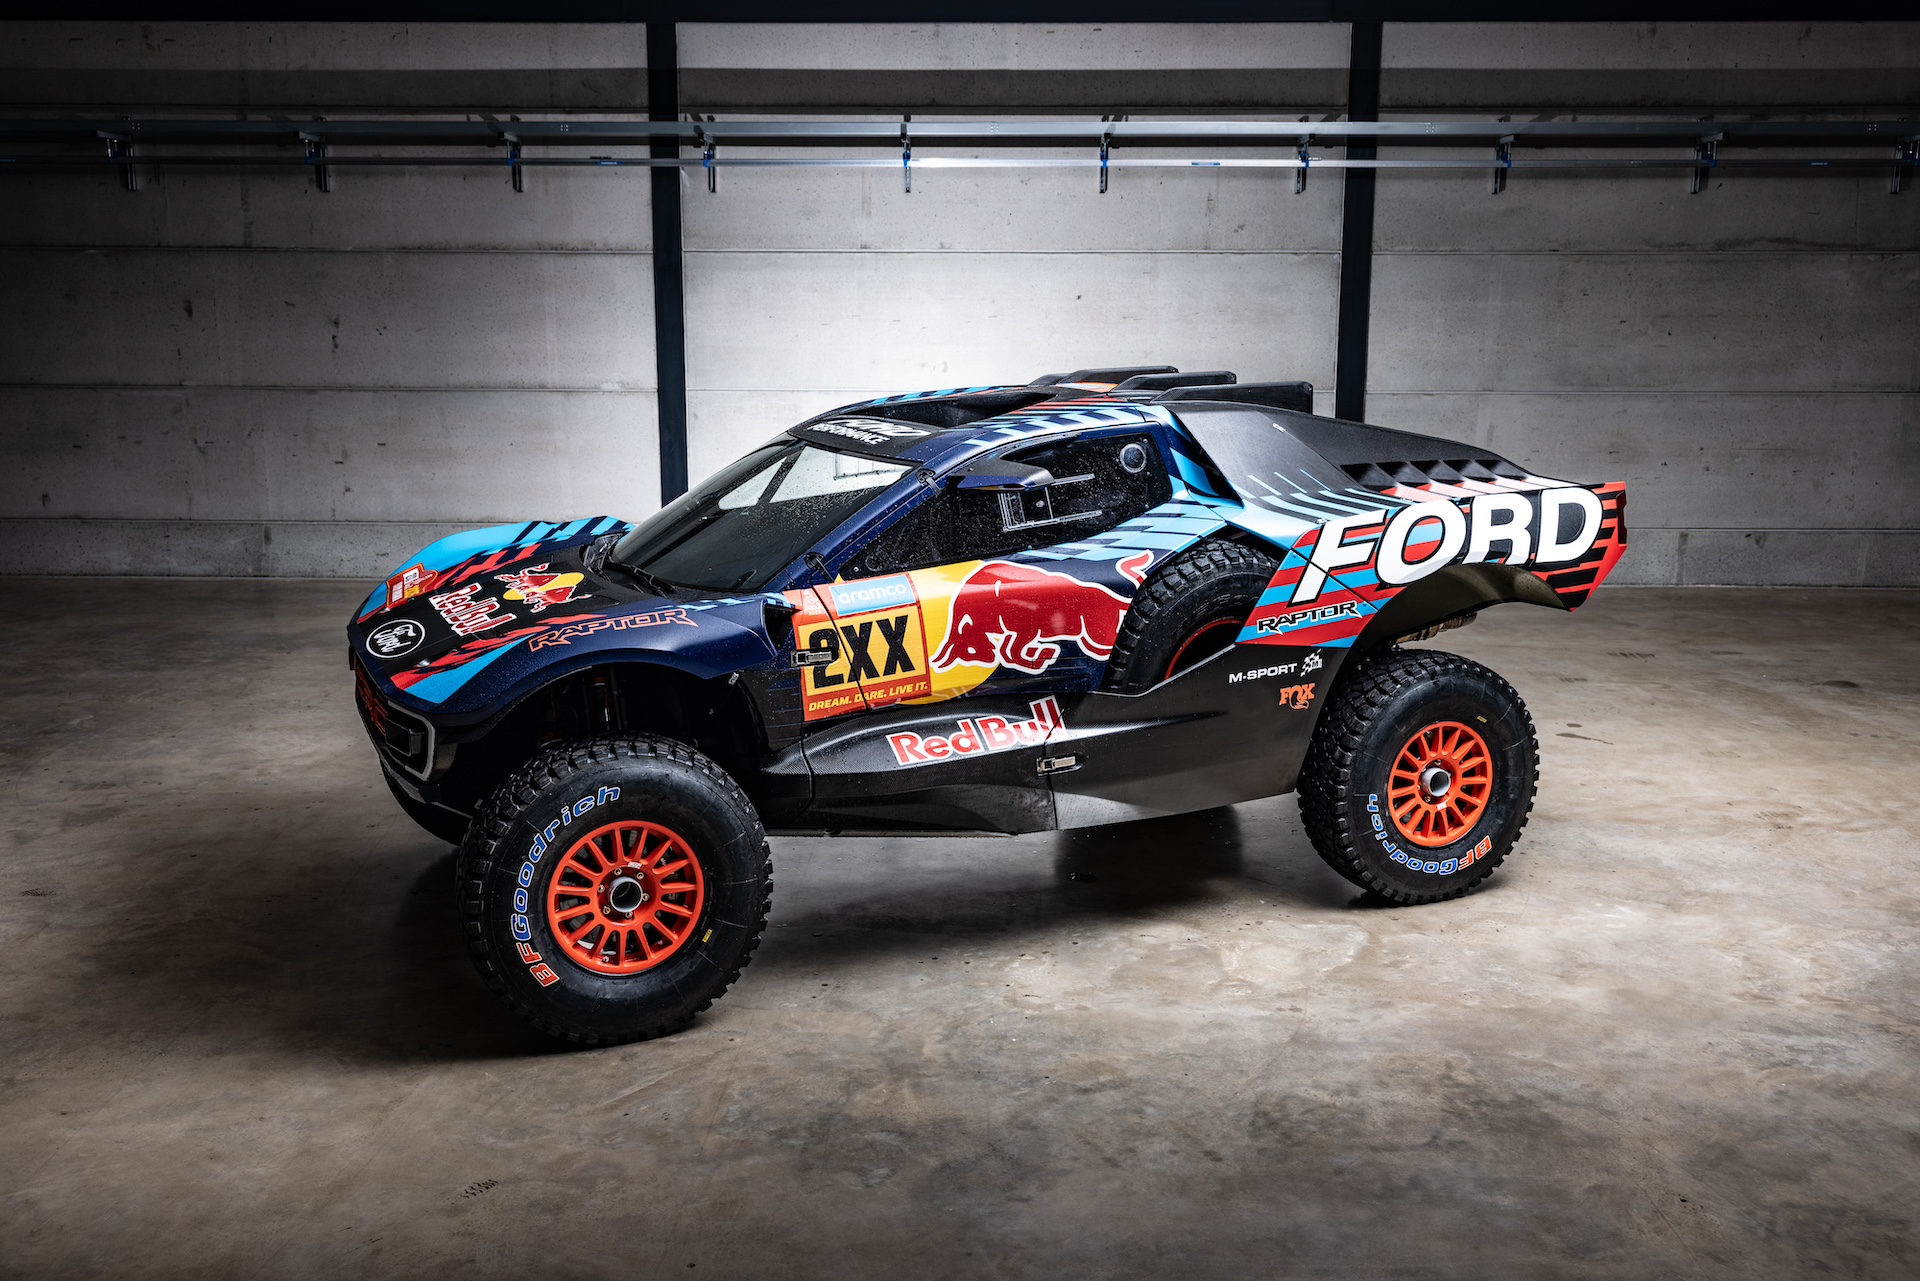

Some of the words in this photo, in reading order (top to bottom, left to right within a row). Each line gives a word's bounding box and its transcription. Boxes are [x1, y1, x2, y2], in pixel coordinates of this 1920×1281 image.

[1289, 486, 1603, 607] FORD
[838, 584, 906, 603] aramco
[528, 608, 699, 652] RAPTOR
[1256, 600, 1363, 635] RAPTOR
[809, 615, 915, 688] 2XX
[1228, 662, 1298, 684] M-SPORT
[808, 698, 852, 712] DREAM.
[854, 690, 887, 703] DARE.
[889, 683, 914, 696] LIVE
[915, 681, 928, 692] IT.
[1279, 682, 1316, 710] FOX
[886, 719, 986, 766] Red
[975, 695, 1069, 751] Bull
[1366, 793, 1493, 876] BFGoodrich
[510, 785, 620, 988] BFGoodrich
